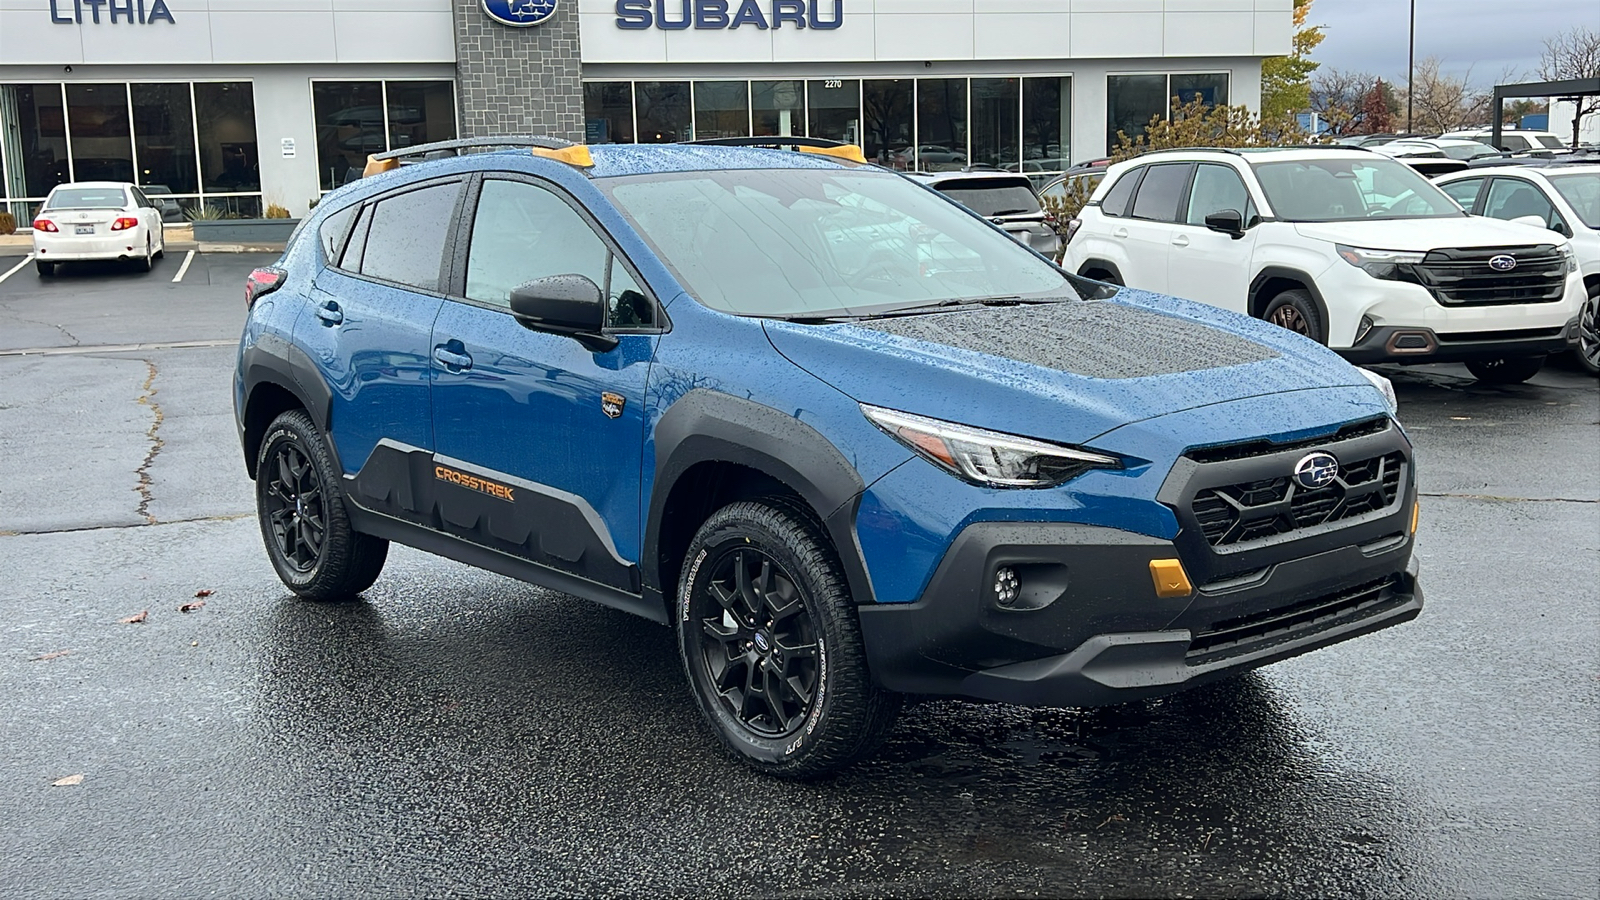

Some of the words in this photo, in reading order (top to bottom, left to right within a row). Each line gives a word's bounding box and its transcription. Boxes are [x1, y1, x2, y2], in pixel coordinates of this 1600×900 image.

[49, 0, 176, 25] LITHIA
[615, 0, 843, 30] SUBARU
[824, 80, 842, 89] 2270
[435, 466, 515, 501] CROSSTREK
